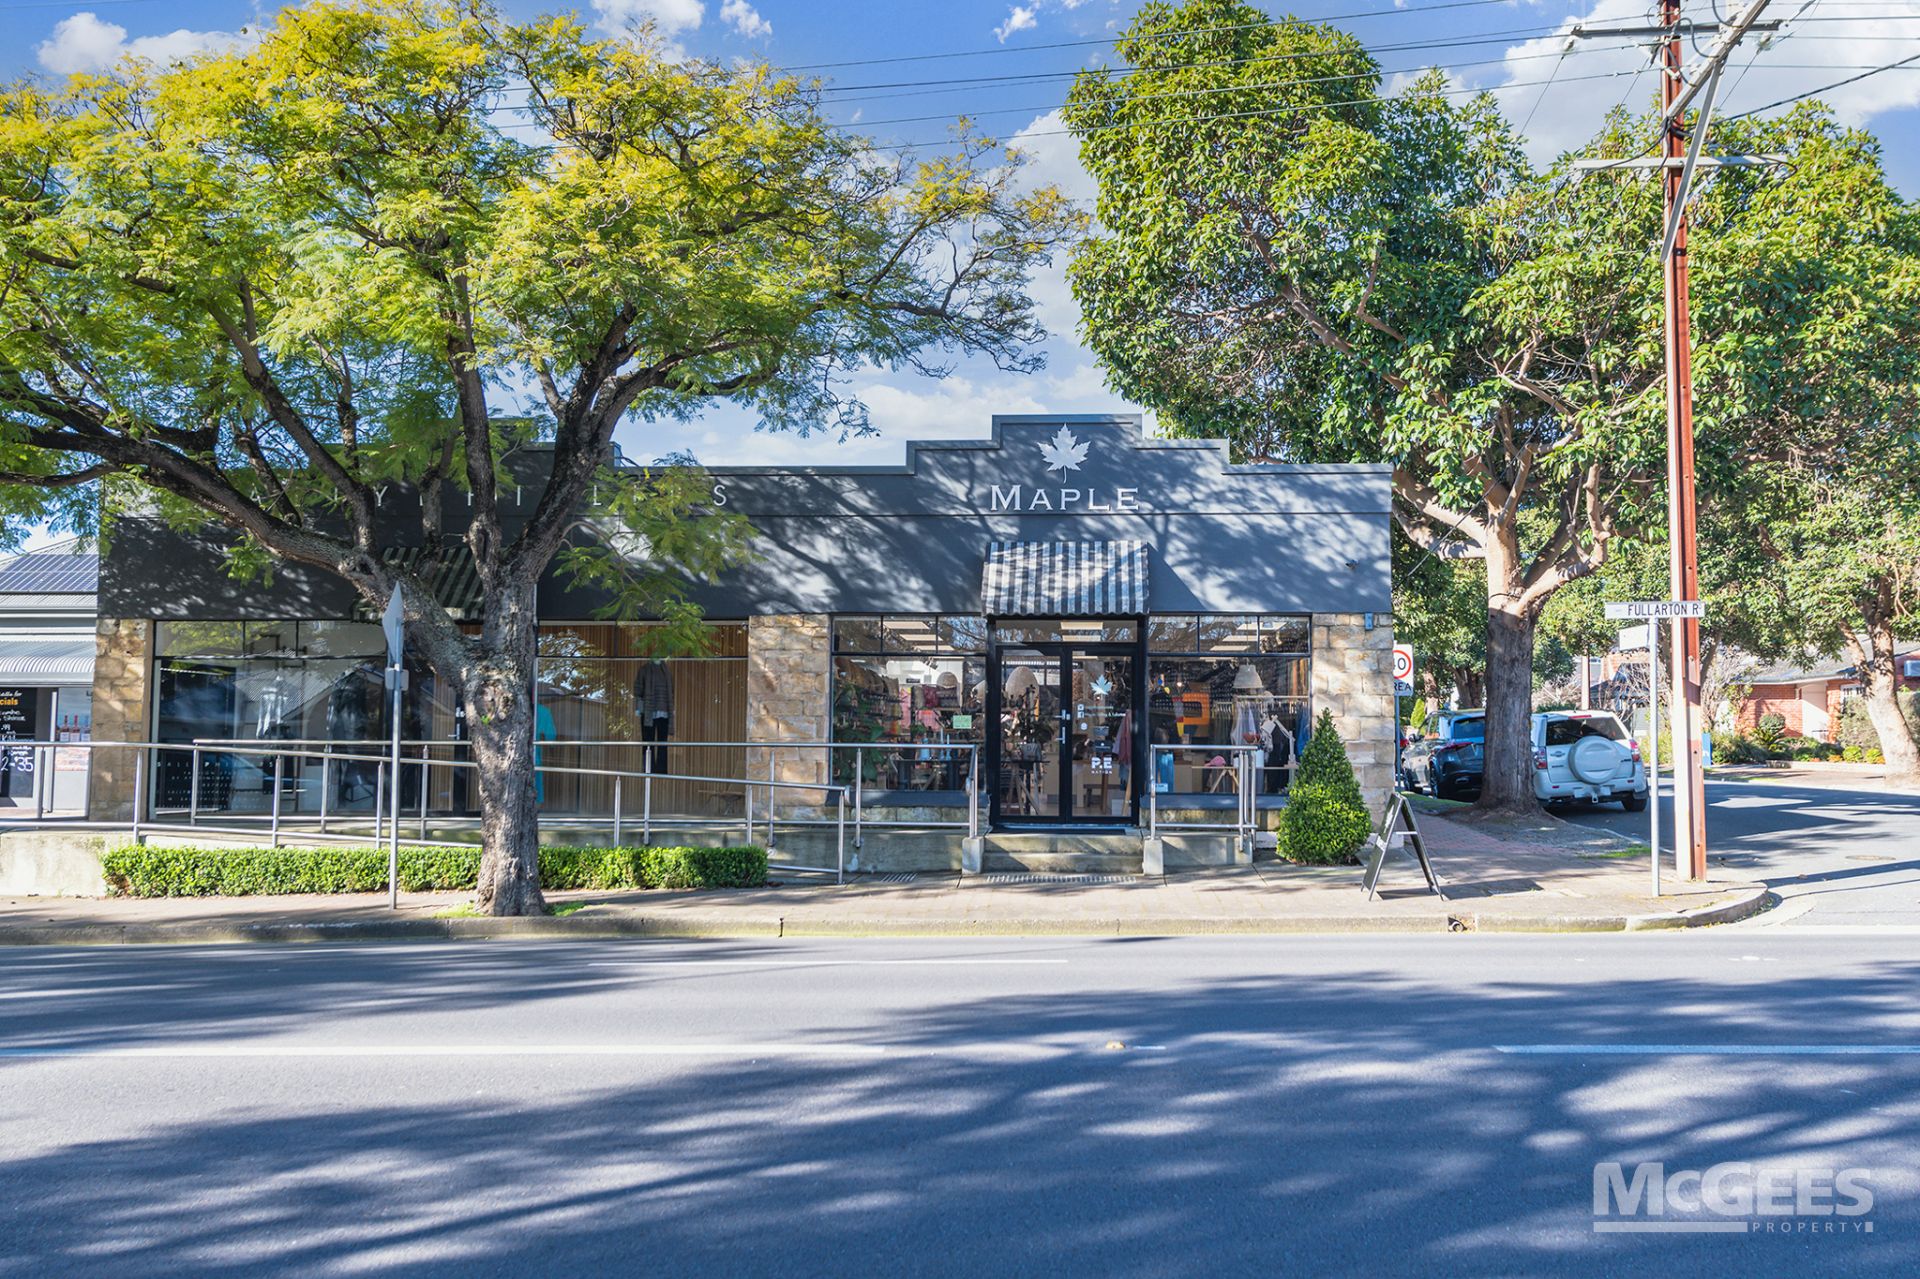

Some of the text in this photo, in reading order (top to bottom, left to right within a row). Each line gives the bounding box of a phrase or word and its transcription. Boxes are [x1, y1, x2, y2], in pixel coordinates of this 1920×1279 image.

[990, 484, 1139, 511] MAPLE
[1628, 603, 1687, 616] FULLARTON
[1393, 657, 1406, 670] 0
[1393, 682, 1412, 691] REA
